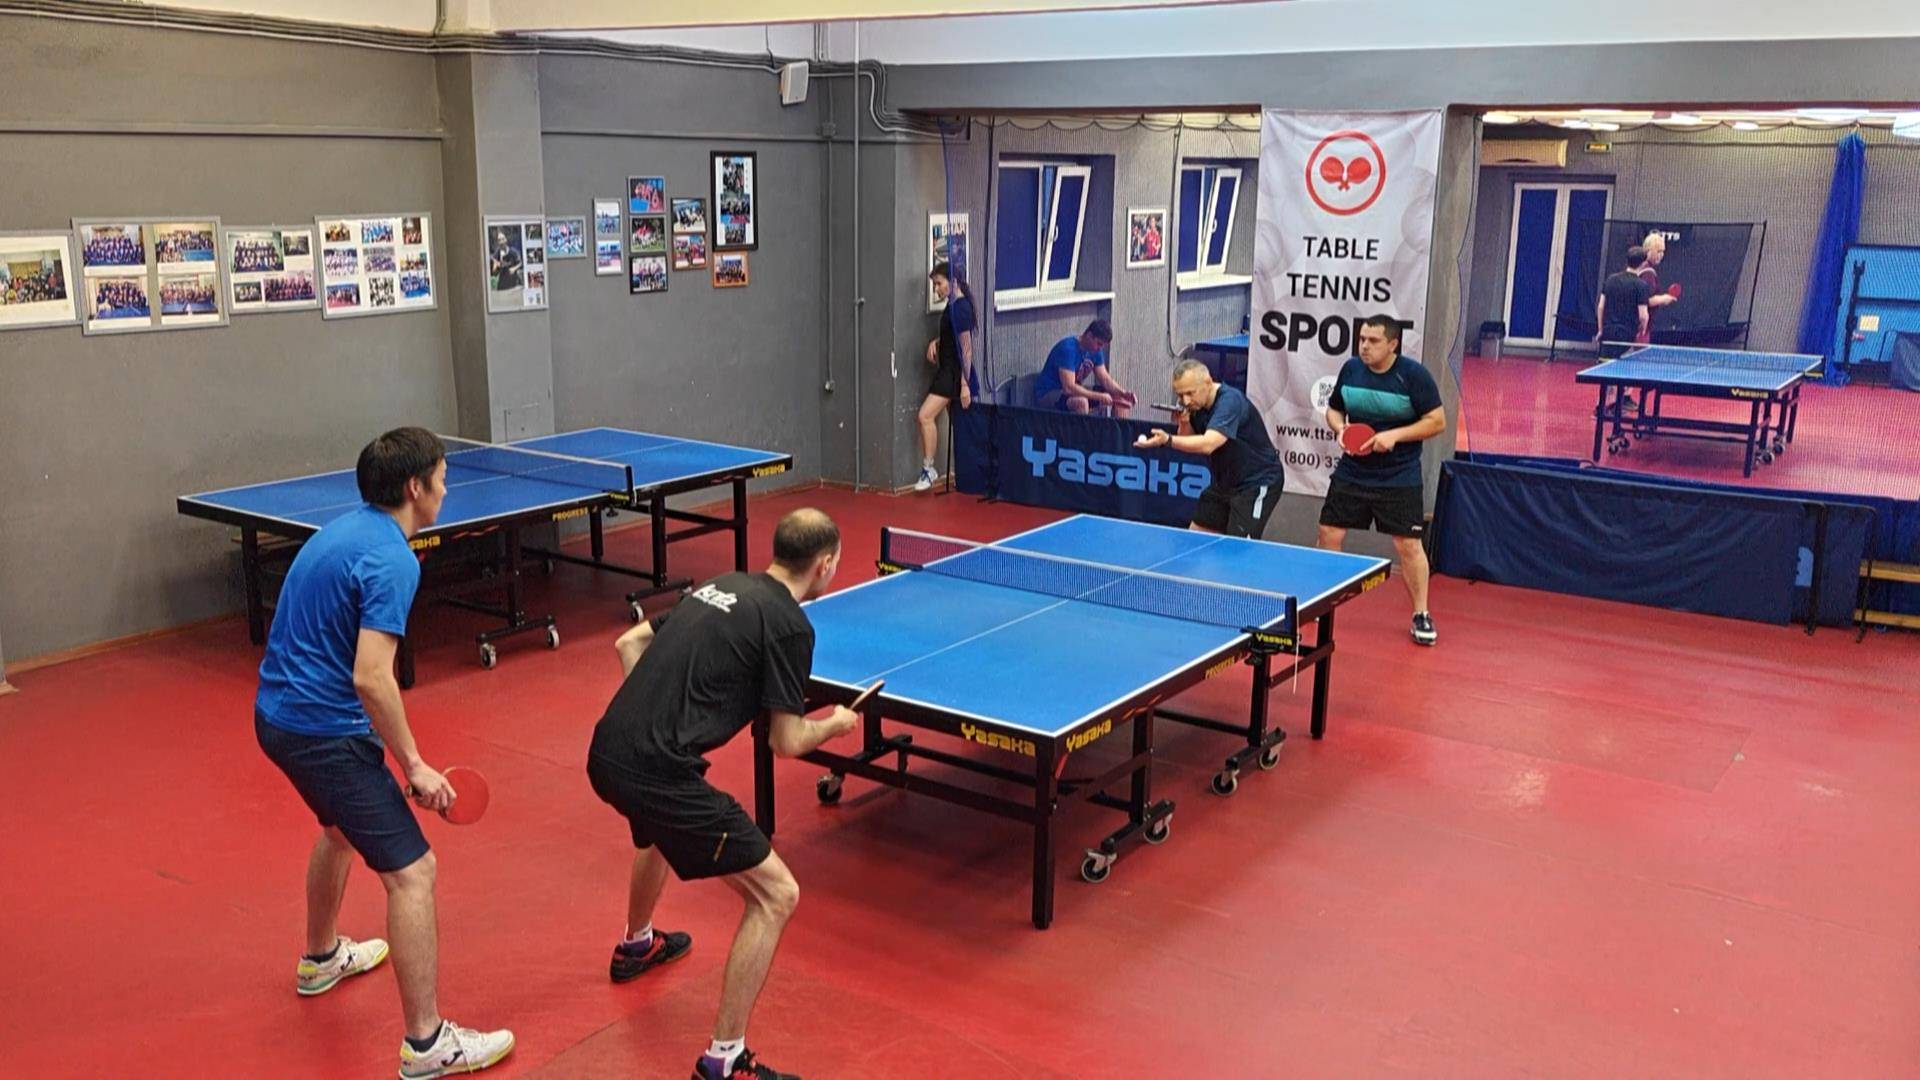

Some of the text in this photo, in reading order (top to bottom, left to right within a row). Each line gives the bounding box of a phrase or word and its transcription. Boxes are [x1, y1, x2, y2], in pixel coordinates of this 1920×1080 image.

[1303, 236, 1380, 260] TABLE
[1286, 273, 1392, 303] TENNIS
[1022, 436, 1212, 498] Yasaka
[1284, 450, 1320, 469] (800)
[961, 722, 1036, 757] Yasaka
[1065, 719, 1113, 752] Yasaka
